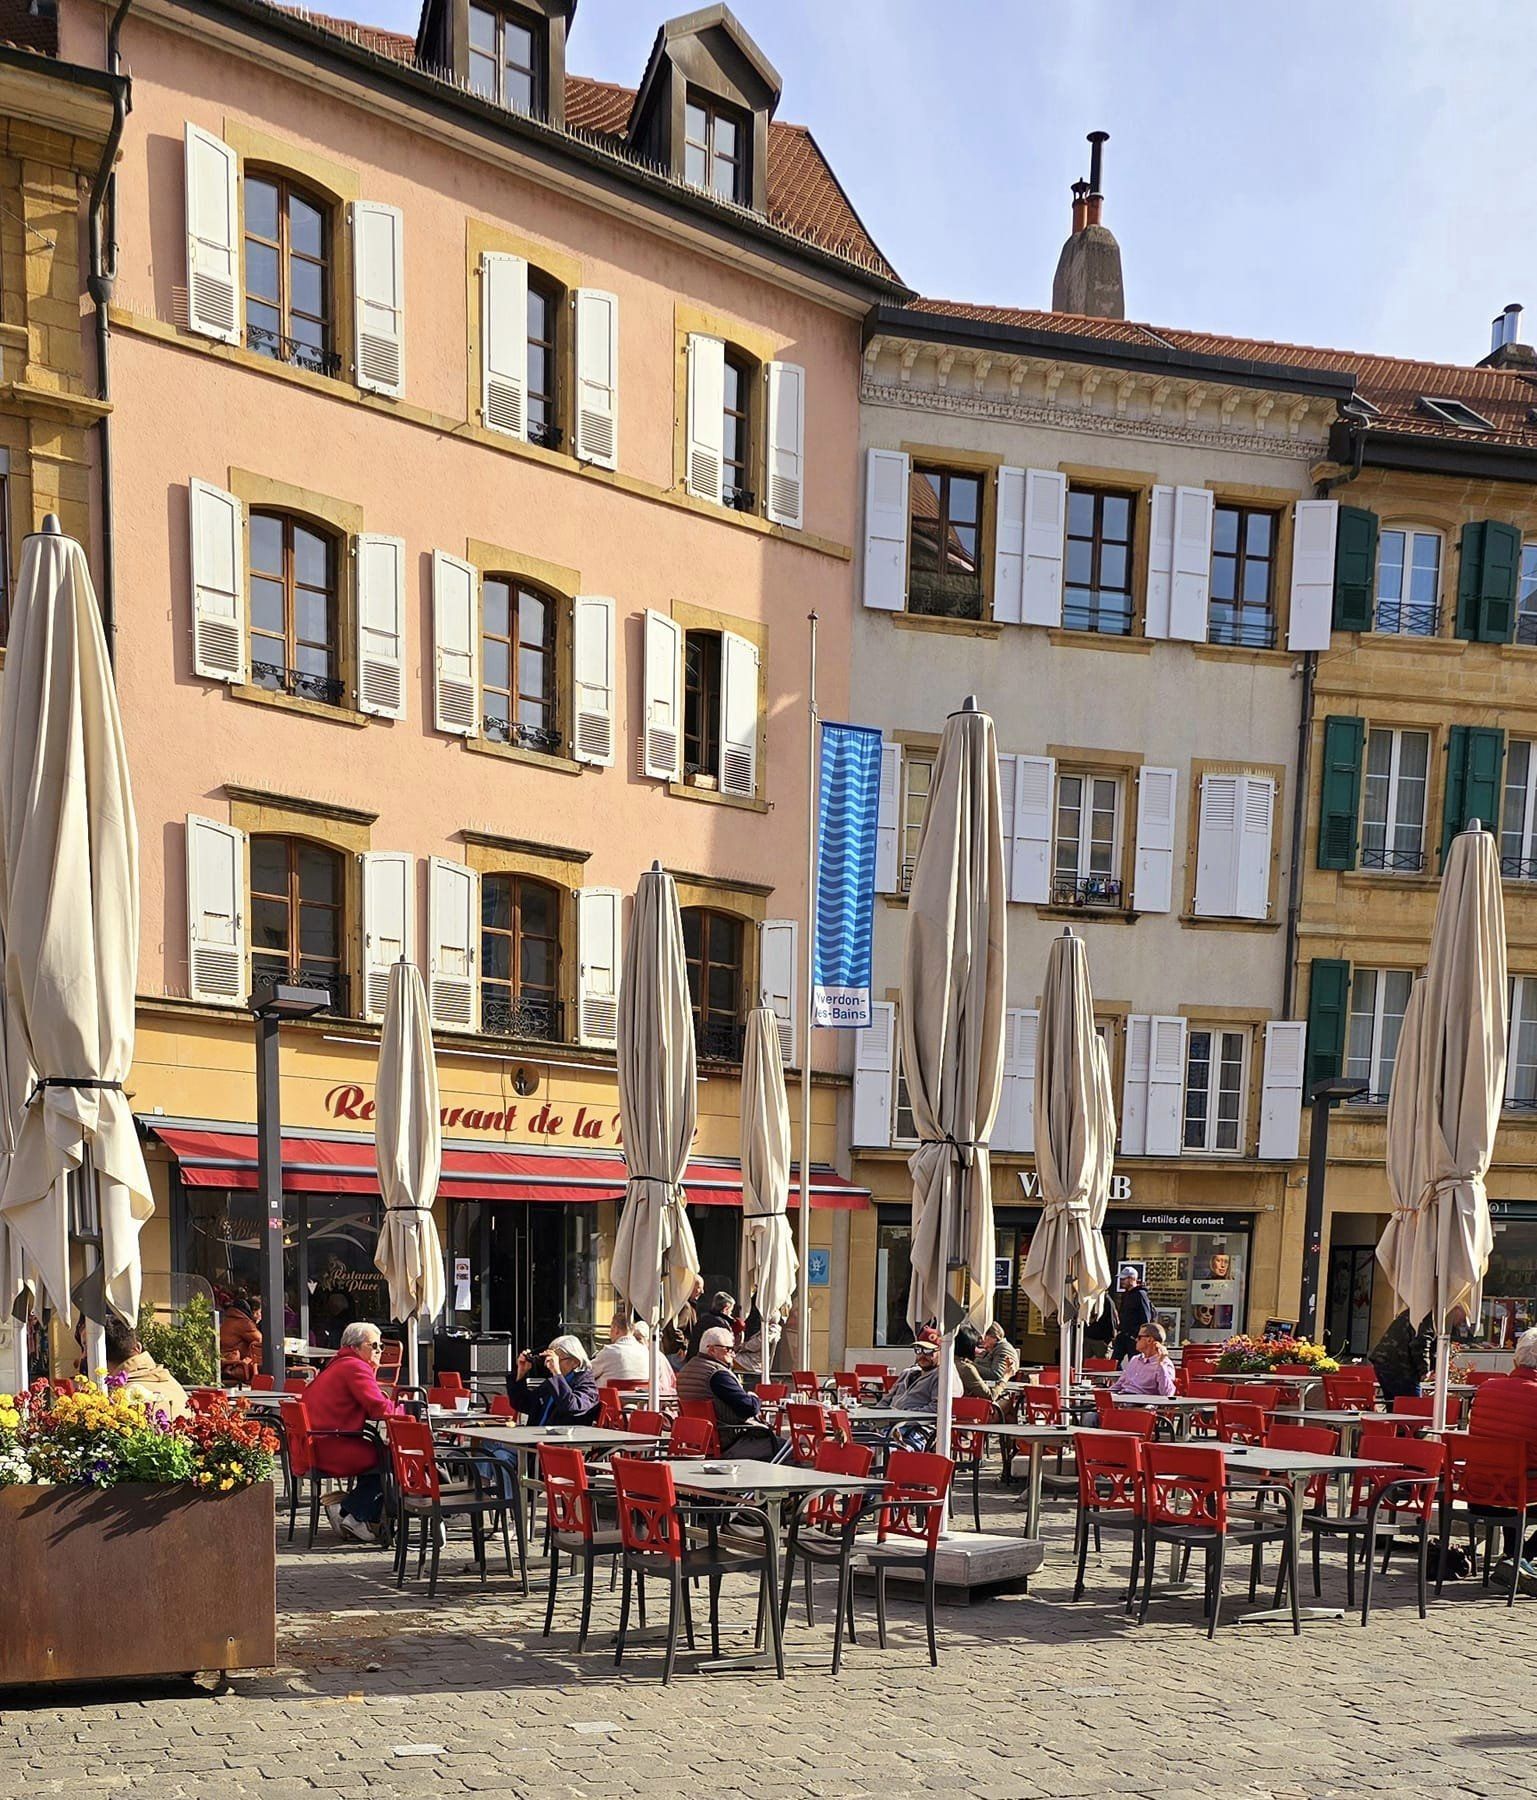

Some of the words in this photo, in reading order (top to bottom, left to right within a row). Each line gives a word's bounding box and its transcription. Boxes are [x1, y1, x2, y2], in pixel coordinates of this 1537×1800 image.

[815, 1007, 867, 1020] les-Bains
[325, 1084, 518, 1132] Rerant
[528, 1103, 565, 1136] de
[572, 1106, 604, 1139] la
[1142, 1214, 1178, 1224] Lentilles
[1179, 1215, 1190, 1224] de
[1192, 1216, 1224, 1225] contact
[331, 1270, 385, 1280] Restaura
